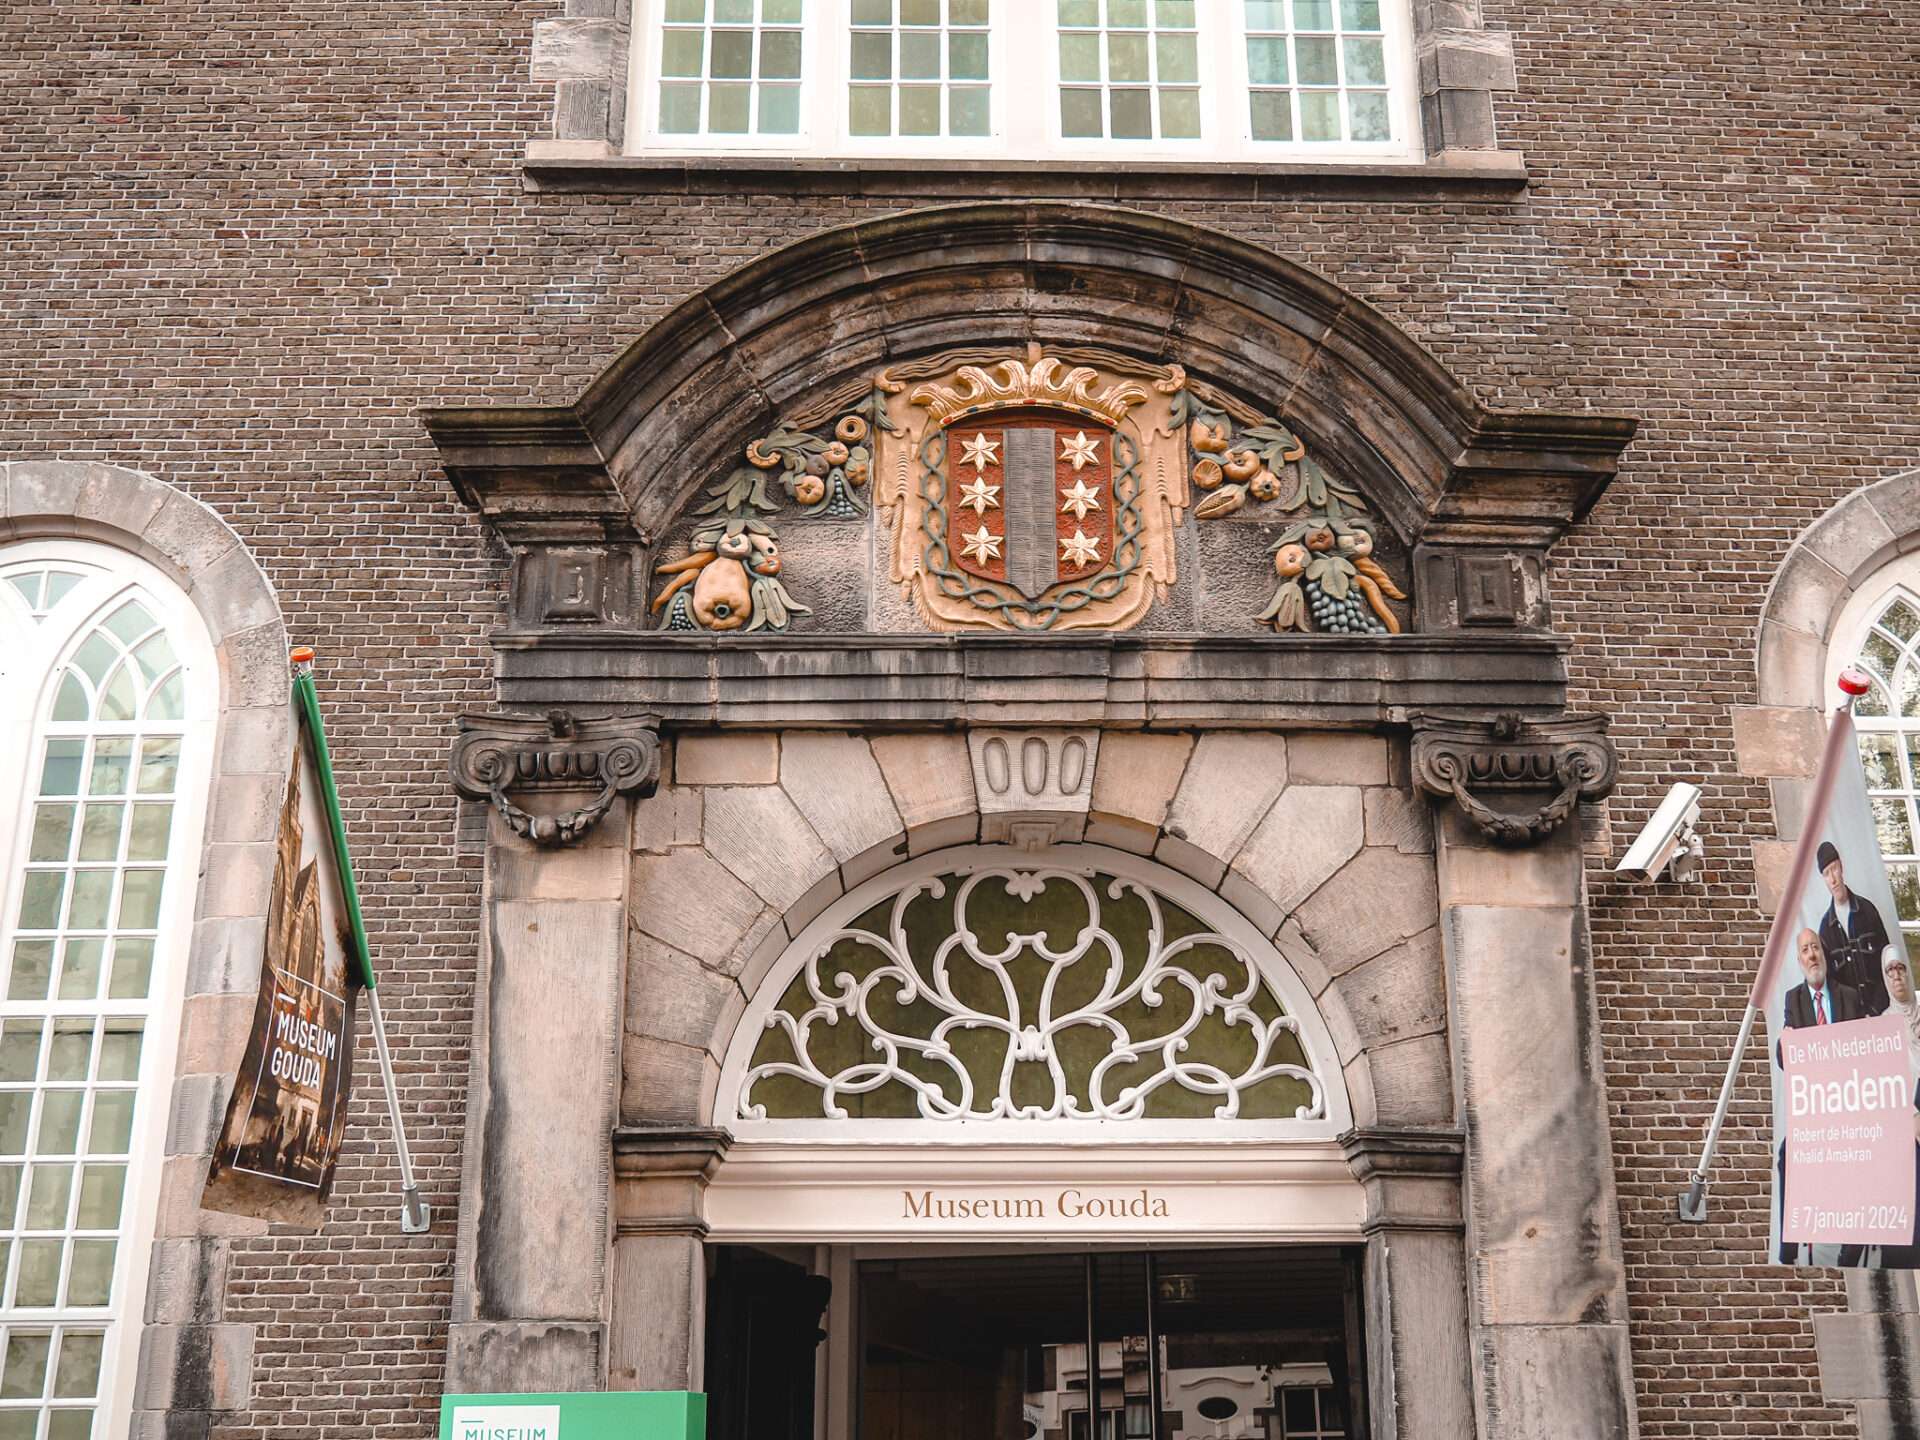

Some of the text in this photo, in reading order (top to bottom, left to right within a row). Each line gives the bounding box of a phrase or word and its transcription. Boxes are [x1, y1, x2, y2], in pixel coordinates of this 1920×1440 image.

[276, 1010, 336, 1061] MUSEUM
[1788, 1031, 1902, 1065] De Mix Nederland
[271, 1047, 322, 1090] GOUDA
[1791, 1068, 1907, 1116] Bnadem
[1792, 1123, 1883, 1143] Robert de Hartogh
[1792, 1147, 1872, 1164] Khalid Amakran
[902, 1189, 1170, 1219] Museum Gouda
[1803, 1206, 1812, 1227] 7
[1812, 1207, 1865, 1234] januari
[1868, 1206, 1907, 1229] 2024
[465, 1428, 546, 1440] MUSEUM
